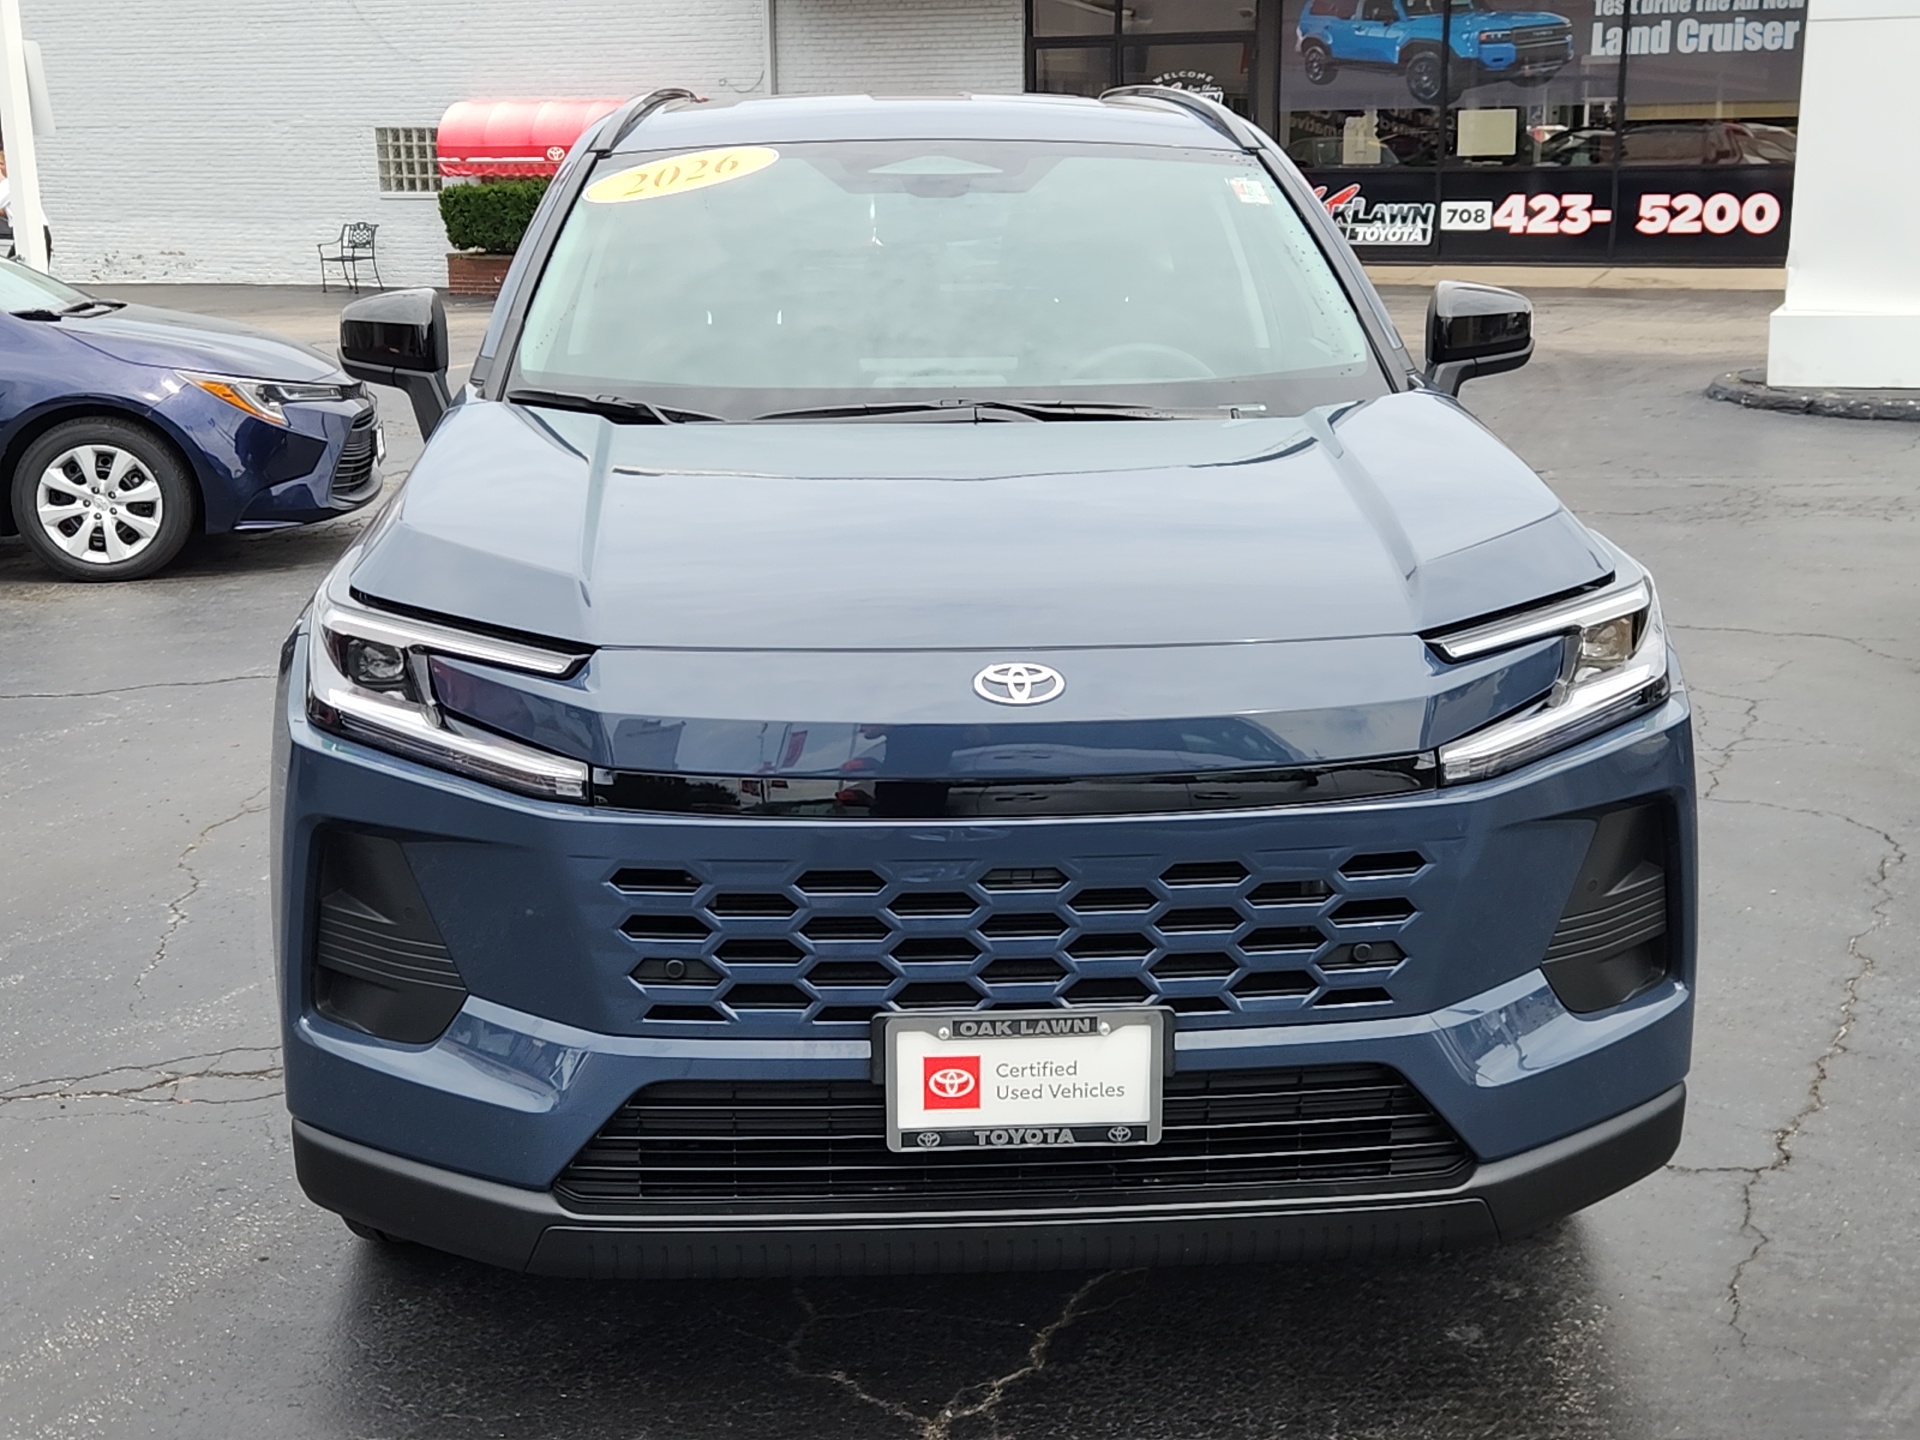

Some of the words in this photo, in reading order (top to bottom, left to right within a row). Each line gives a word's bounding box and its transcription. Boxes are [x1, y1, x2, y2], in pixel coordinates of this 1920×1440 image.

[1641, 0, 1691, 14] Drive
[1591, 20, 1672, 56] Land
[1677, 17, 1800, 53] Cruiser
[1152, 71, 1214, 83] WELCOME
[622, 154, 738, 197] 2026
[1446, 208, 1486, 224] 708
[1493, 194, 1612, 234] 423-
[1635, 193, 1780, 234] 5200
[1355, 227, 1424, 242] TOYOTA
[959, 1020, 1013, 1036] OAK
[1020, 1018, 1090, 1035] LAWN
[996, 1060, 1078, 1078] Certified
[996, 1084, 1043, 1100] Used
[1049, 1082, 1125, 1099] Vehicles
[974, 1128, 1075, 1146] TOYOTA
